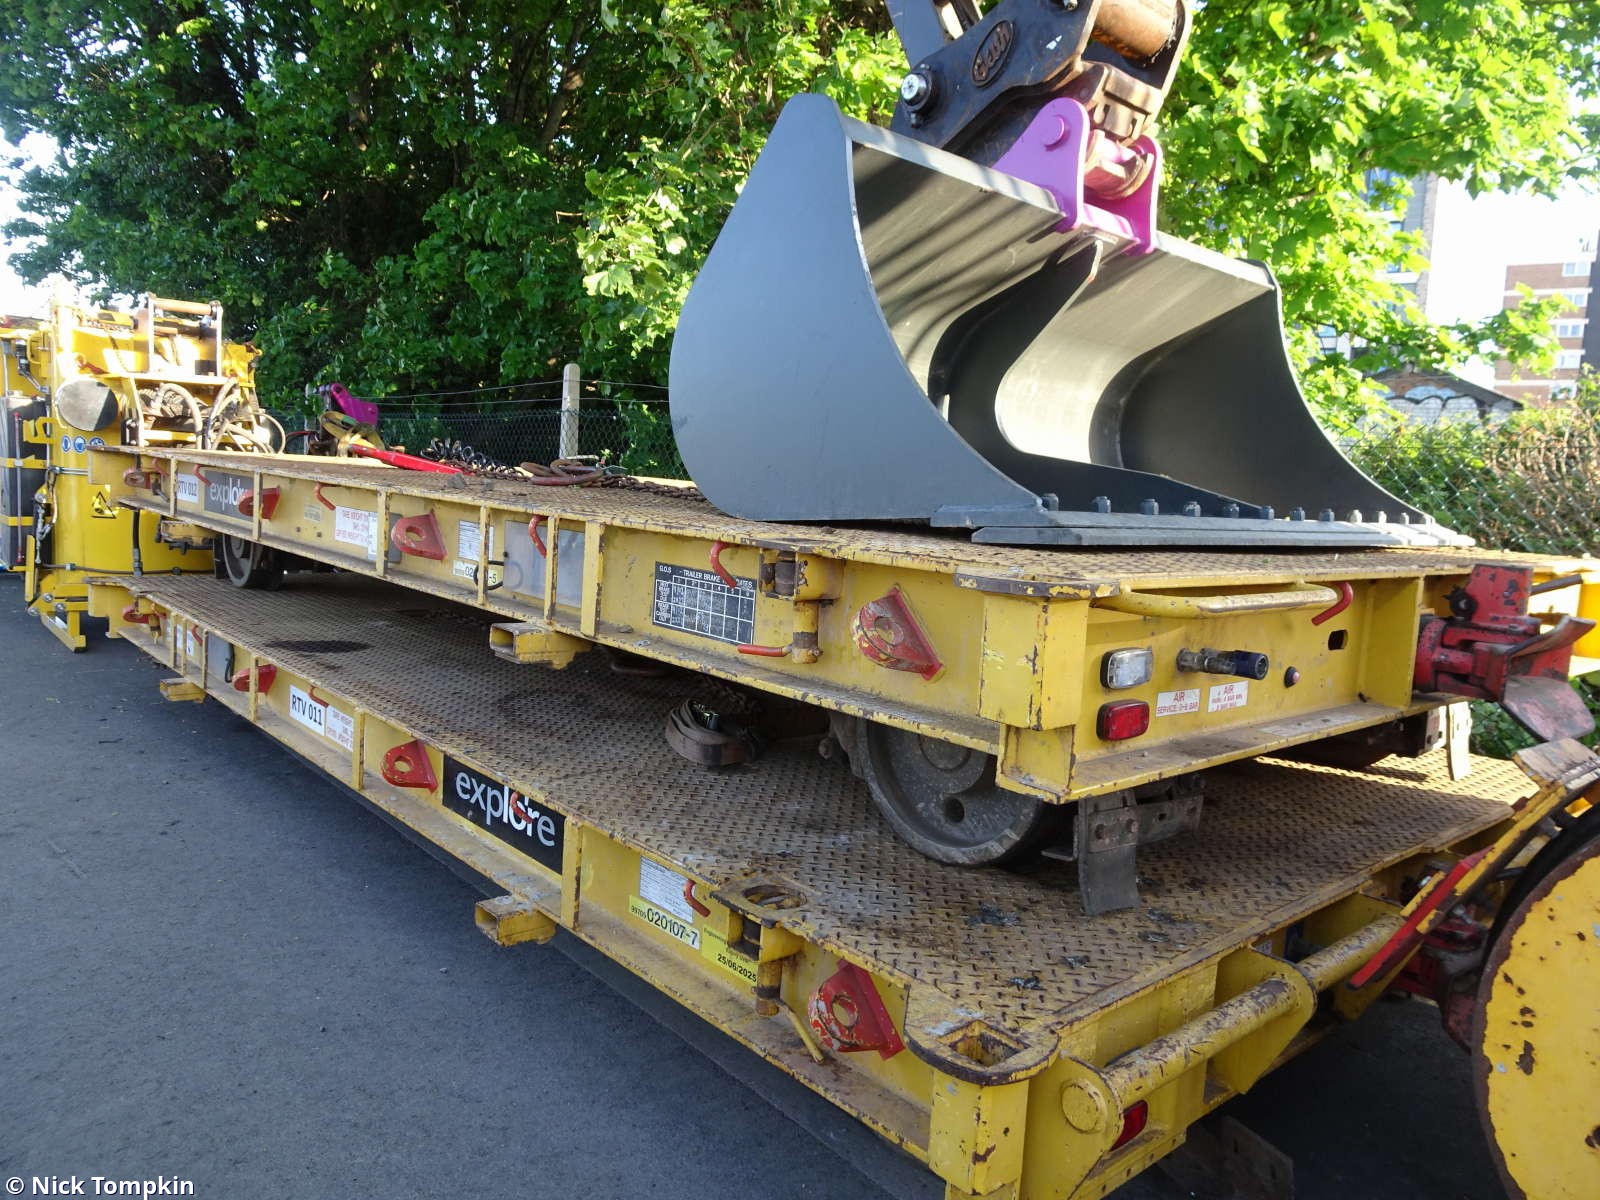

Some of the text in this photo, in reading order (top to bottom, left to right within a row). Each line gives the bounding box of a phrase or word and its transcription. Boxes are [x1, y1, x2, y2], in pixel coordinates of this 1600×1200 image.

[188, 481, 197, 497] 012
[683, 569, 703, 579] TRAILER
[704, 572, 721, 583] BRAKE
[1173, 691, 1185, 702] AIR
[1223, 685, 1234, 694] AIR
[292, 694, 307, 716] RTV
[308, 703, 322, 726] 011
[455, 771, 556, 847] explore
[646, 907, 698, 946] 020107-7
[717, 953, 757, 983] 25/06/2025
